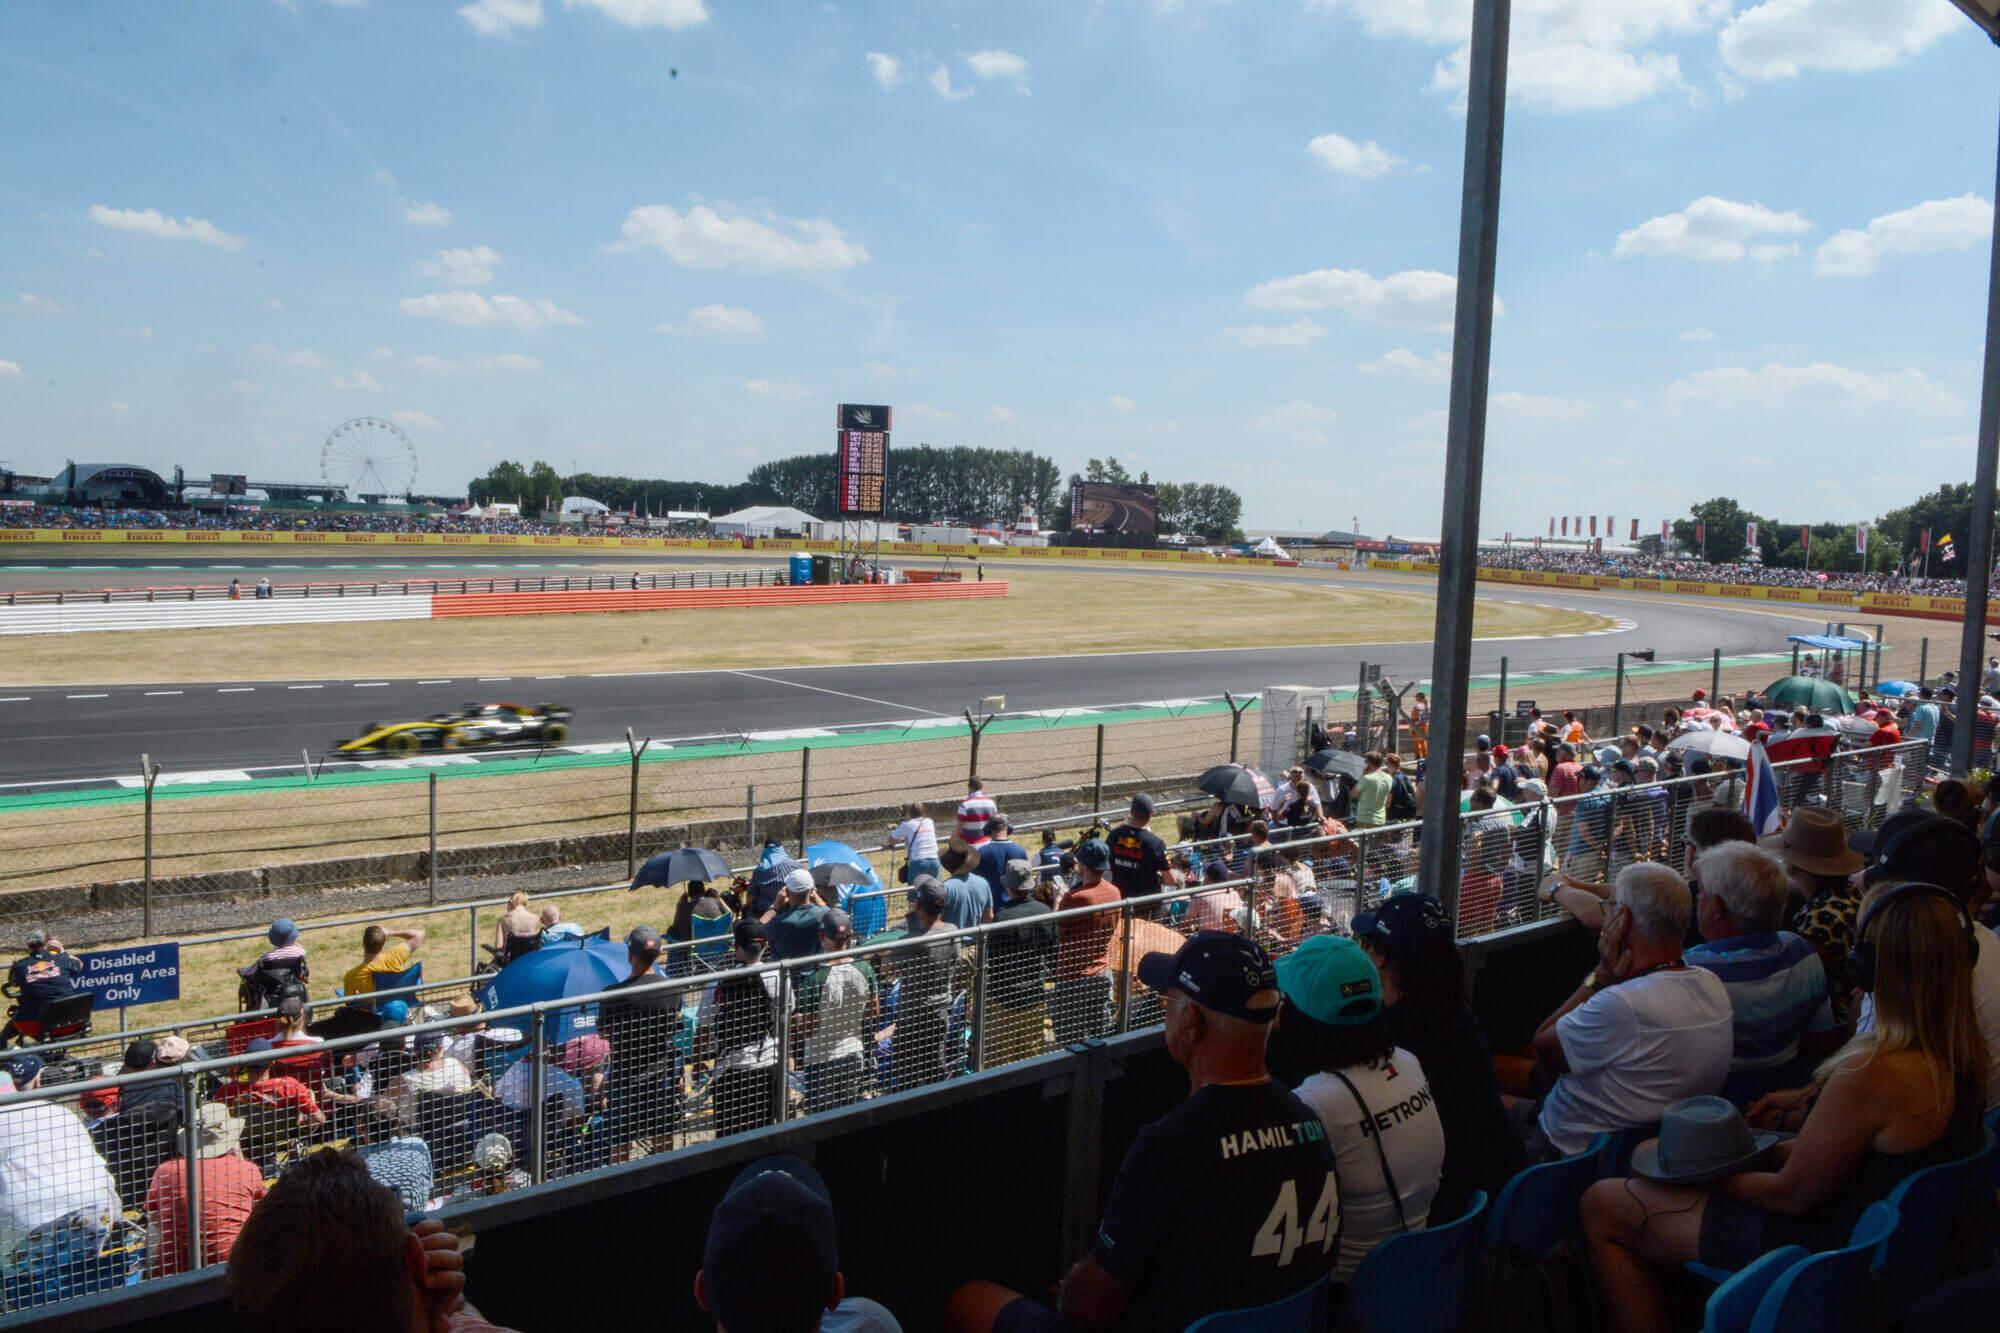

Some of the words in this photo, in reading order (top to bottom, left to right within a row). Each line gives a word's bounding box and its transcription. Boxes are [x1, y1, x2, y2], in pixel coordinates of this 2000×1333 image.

[1676, 584, 1705, 594] PIRELLI
[1720, 587, 1751, 597] PIRELLI
[1767, 589, 1800, 600] PIRELLI
[1818, 592, 1852, 603] PIRELLI
[1873, 596, 1911, 608] PIRELLI
[90, 951, 156, 971] Disabled
[70, 972, 134, 989] Viewing
[141, 967, 177, 981] Area
[106, 986, 142, 1000] Only
[1251, 1170, 1341, 1267] 44
